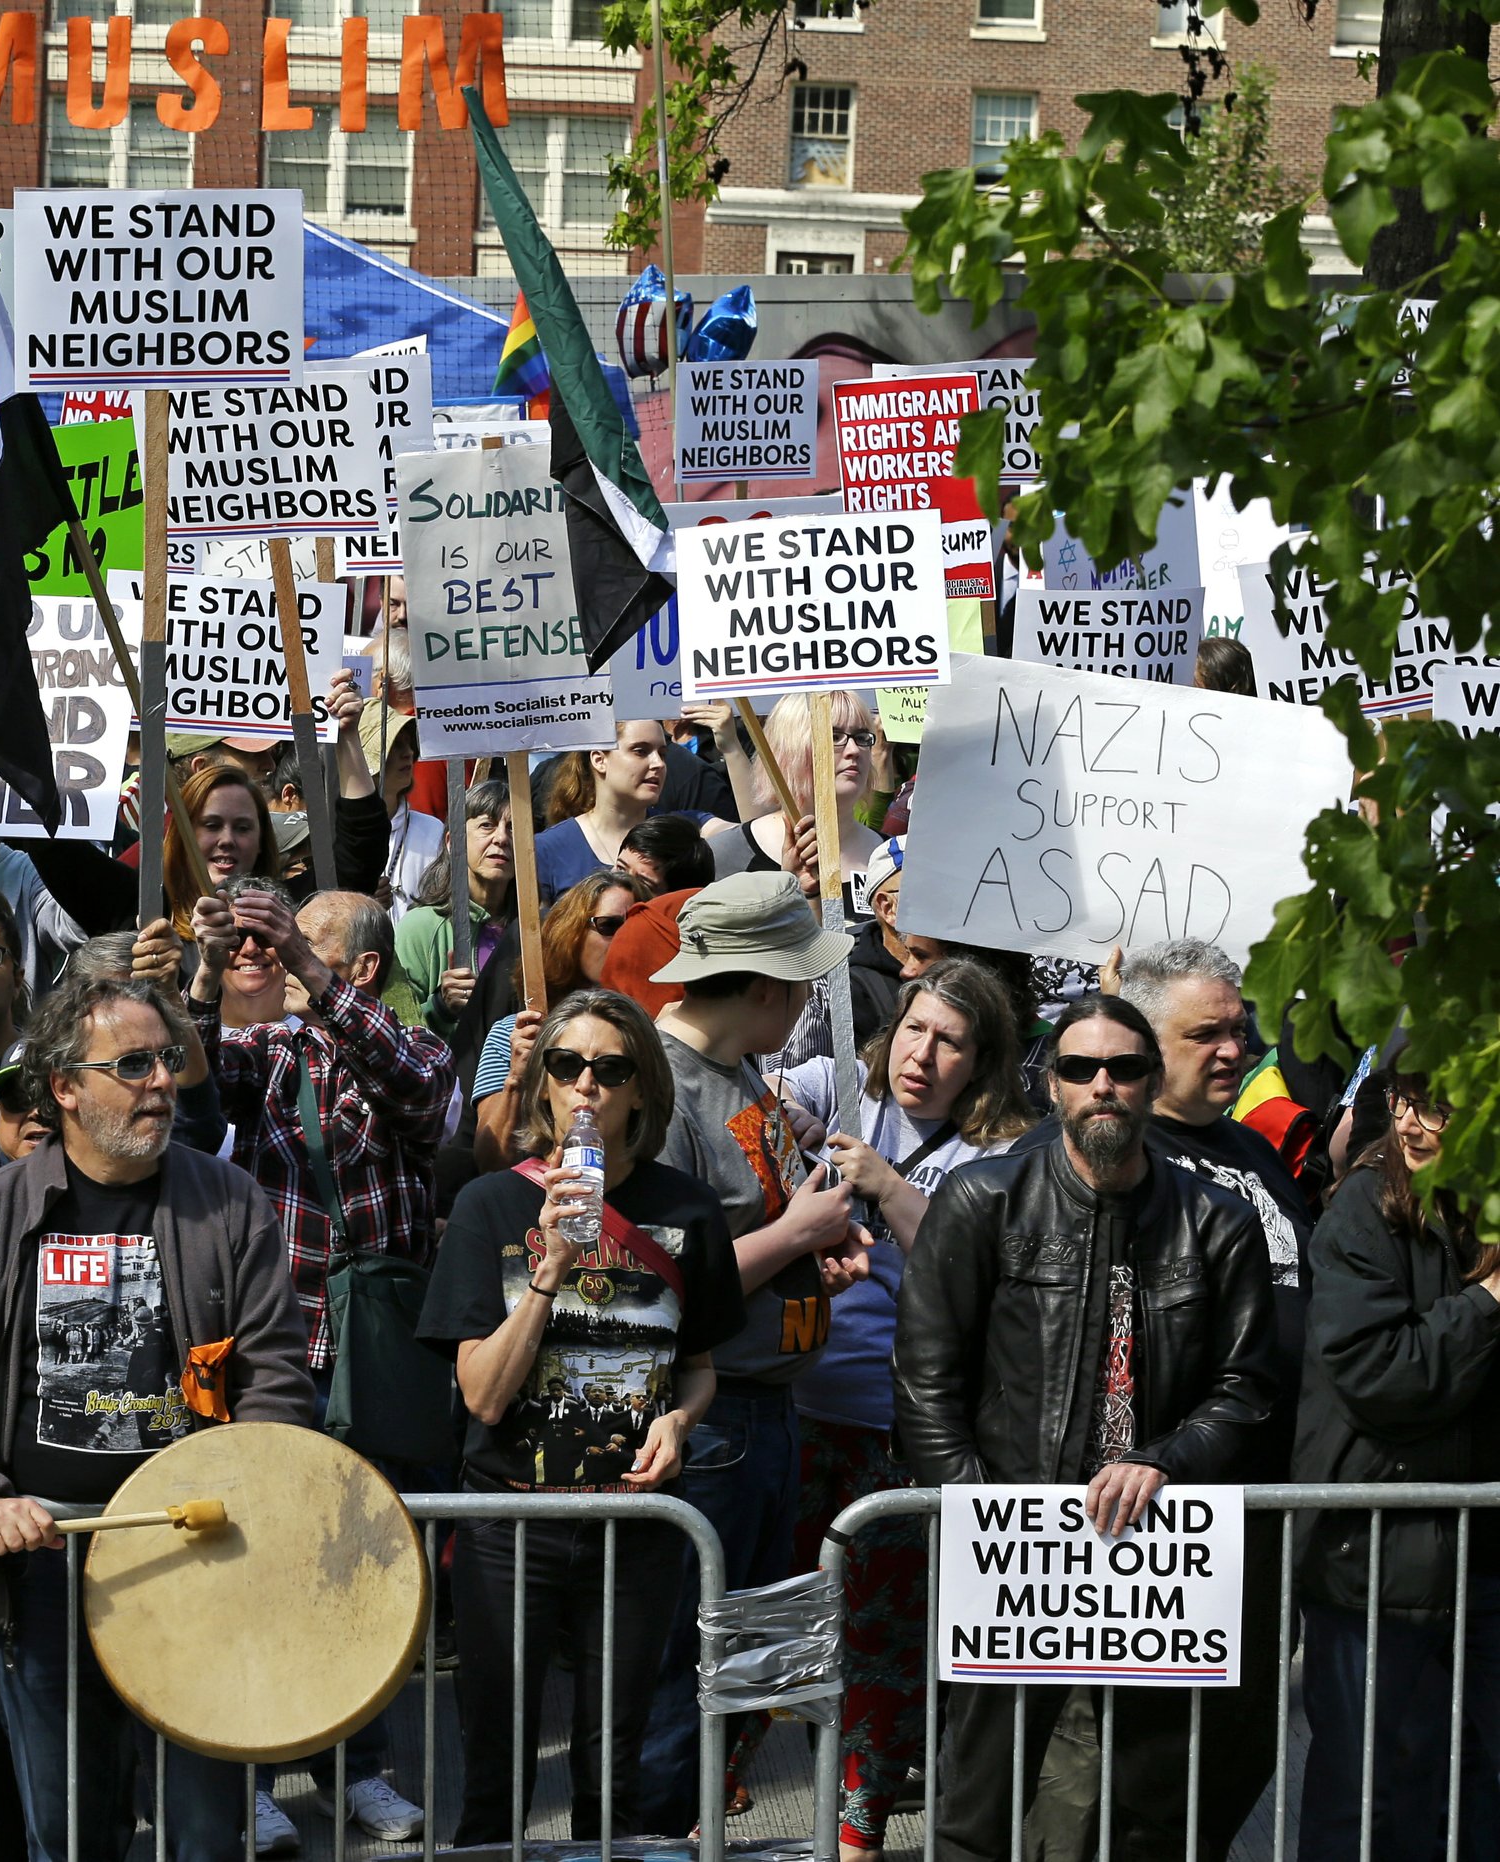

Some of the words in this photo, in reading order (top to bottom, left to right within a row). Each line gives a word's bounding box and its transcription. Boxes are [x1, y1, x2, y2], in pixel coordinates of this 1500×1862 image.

[44, 204, 114, 239] WE
[129, 204, 276, 239] STAND
[45, 247, 161, 282] WITH
[176, 245, 276, 281] OUR
[70, 289, 248, 325] MUSLIM
[29, 330, 291, 369] NEIGHBORS
[690, 370, 724, 391] WE
[730, 368, 805, 390] STAND
[225, 384, 348, 416] STAND
[691, 395, 747, 417] WITH
[753, 394, 804, 415] OUR
[838, 387, 972, 423] IMMIGRANT
[168, 423, 259, 454] WITH
[269, 419, 355, 448] OUR
[702, 420, 791, 442] MUSLIM
[841, 421, 926, 453] RIGHTS
[185, 454, 338, 488] MUSLIM
[681, 443, 811, 468] NEIGHBORS
[168, 488, 377, 524] NEIGHBORS
[847, 482, 931, 512] RIGHTS
[441, 546, 468, 569] IS
[495, 538, 553, 564] OUR
[702, 532, 765, 566] WE
[778, 524, 915, 560] STAND
[443, 572, 555, 615] BEST
[704, 566, 811, 602] WITH
[825, 561, 918, 593] OUR
[729, 600, 896, 638] MUSLIM
[1038, 599, 1091, 626] WE
[1101, 599, 1191, 626] STAND
[425, 615, 586, 661] DEFENSE
[1037, 631, 1125, 658] WITH
[1134, 630, 1188, 658] OUR
[693, 634, 938, 679] NEIGHBORS
[416, 703, 490, 720] Freedom
[494, 696, 568, 714] Socialist
[570, 690, 615, 707] Party
[443, 710, 591, 733] www.socialism.com
[991, 687, 1223, 784] NAZIS
[1011, 778, 1188, 841] SUPPORT
[963, 846, 1233, 947] ASSAD
[46, 1252, 106, 1283] LIFE
[85, 1389, 121, 1416] Bridge
[972, 1498, 1044, 1532] WE
[972, 1540, 1093, 1575] WITH
[1108, 1540, 1213, 1577] OUR
[995, 1583, 1185, 1620] MUSLIM
[952, 1624, 1228, 1664] NEIGHBORS
